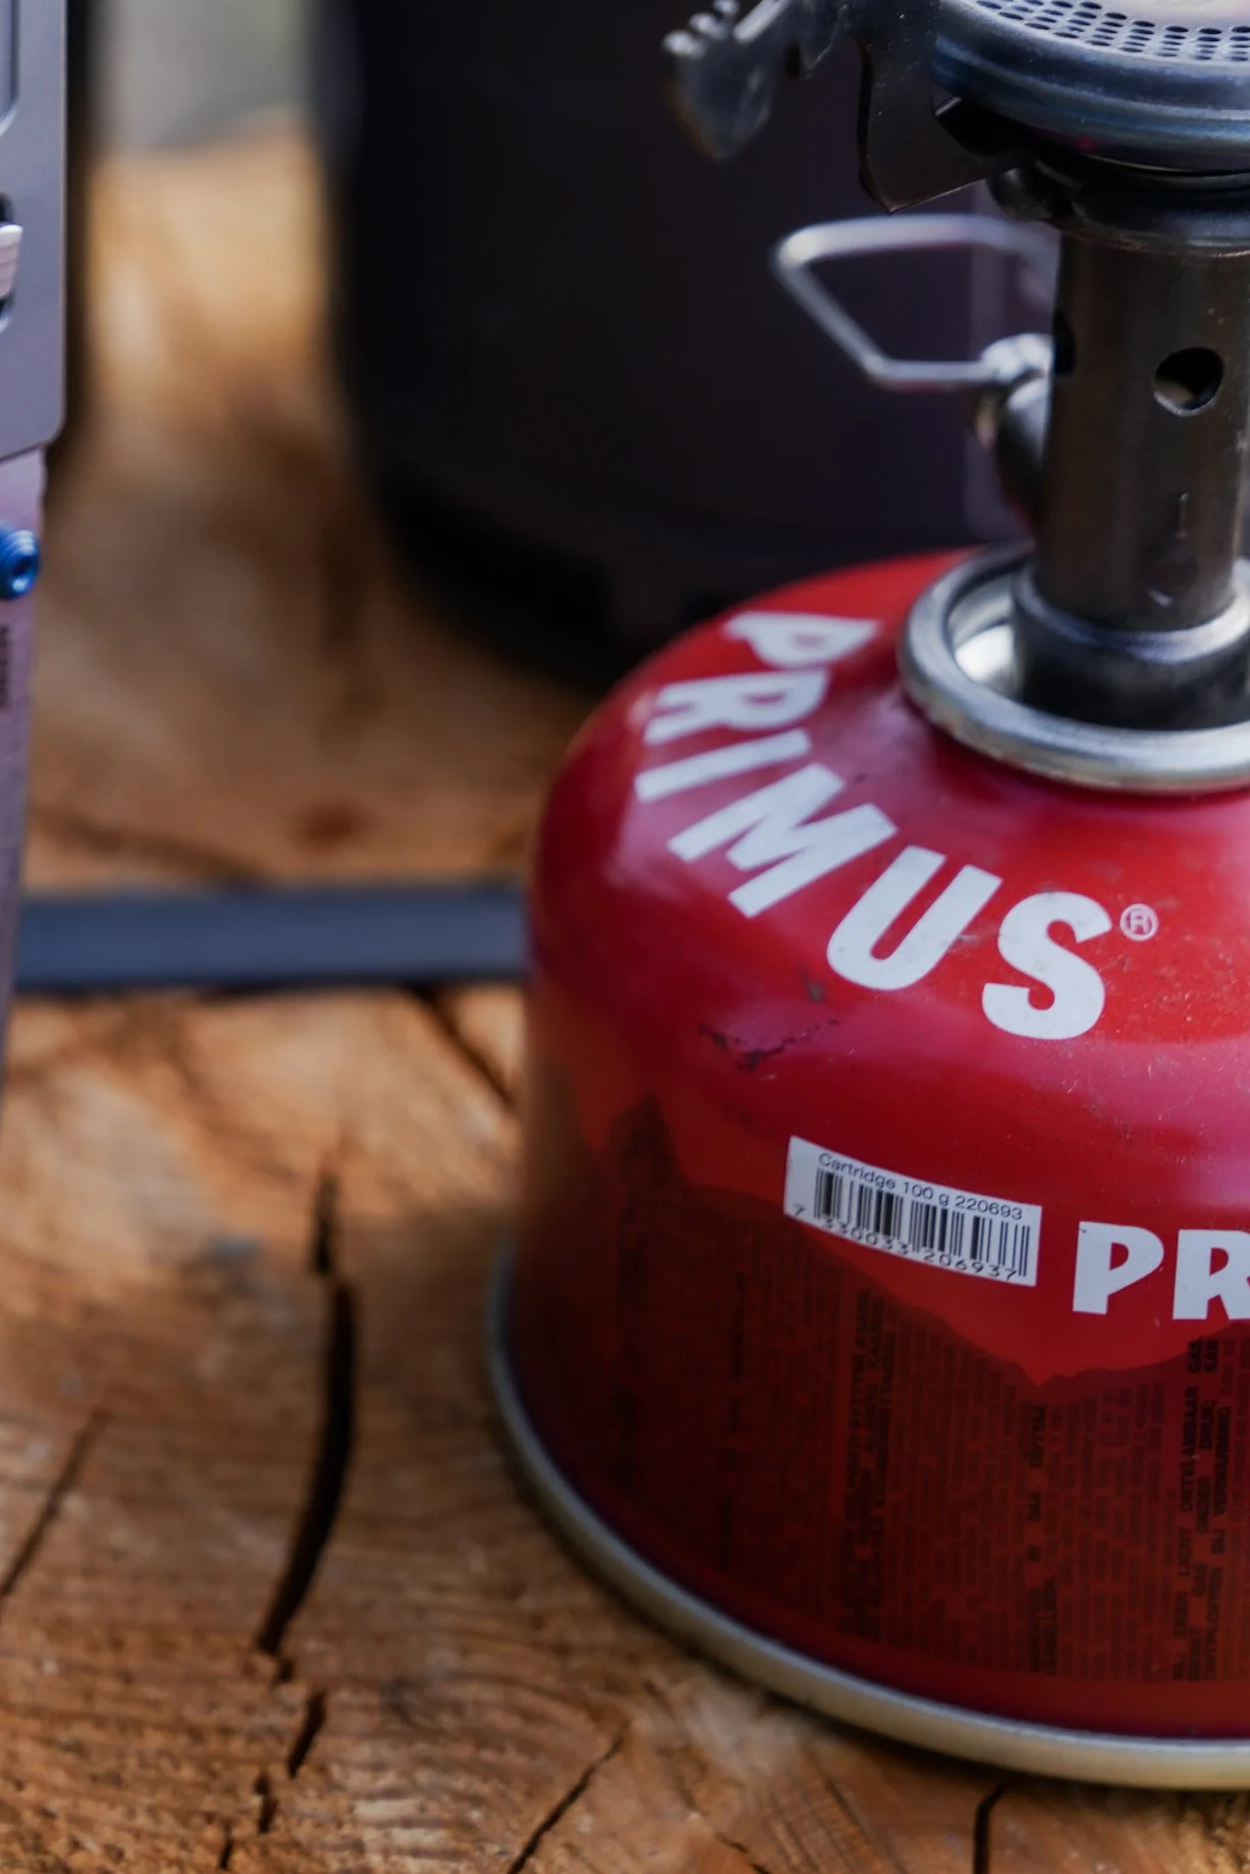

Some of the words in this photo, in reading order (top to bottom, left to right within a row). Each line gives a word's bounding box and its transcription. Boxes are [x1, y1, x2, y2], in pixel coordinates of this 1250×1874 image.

[818, 1152, 897, 1191] Cartridge
[902, 1181, 934, 1201] 100
[938, 1194, 950, 1208] g
[954, 1194, 1024, 1222] 220693
